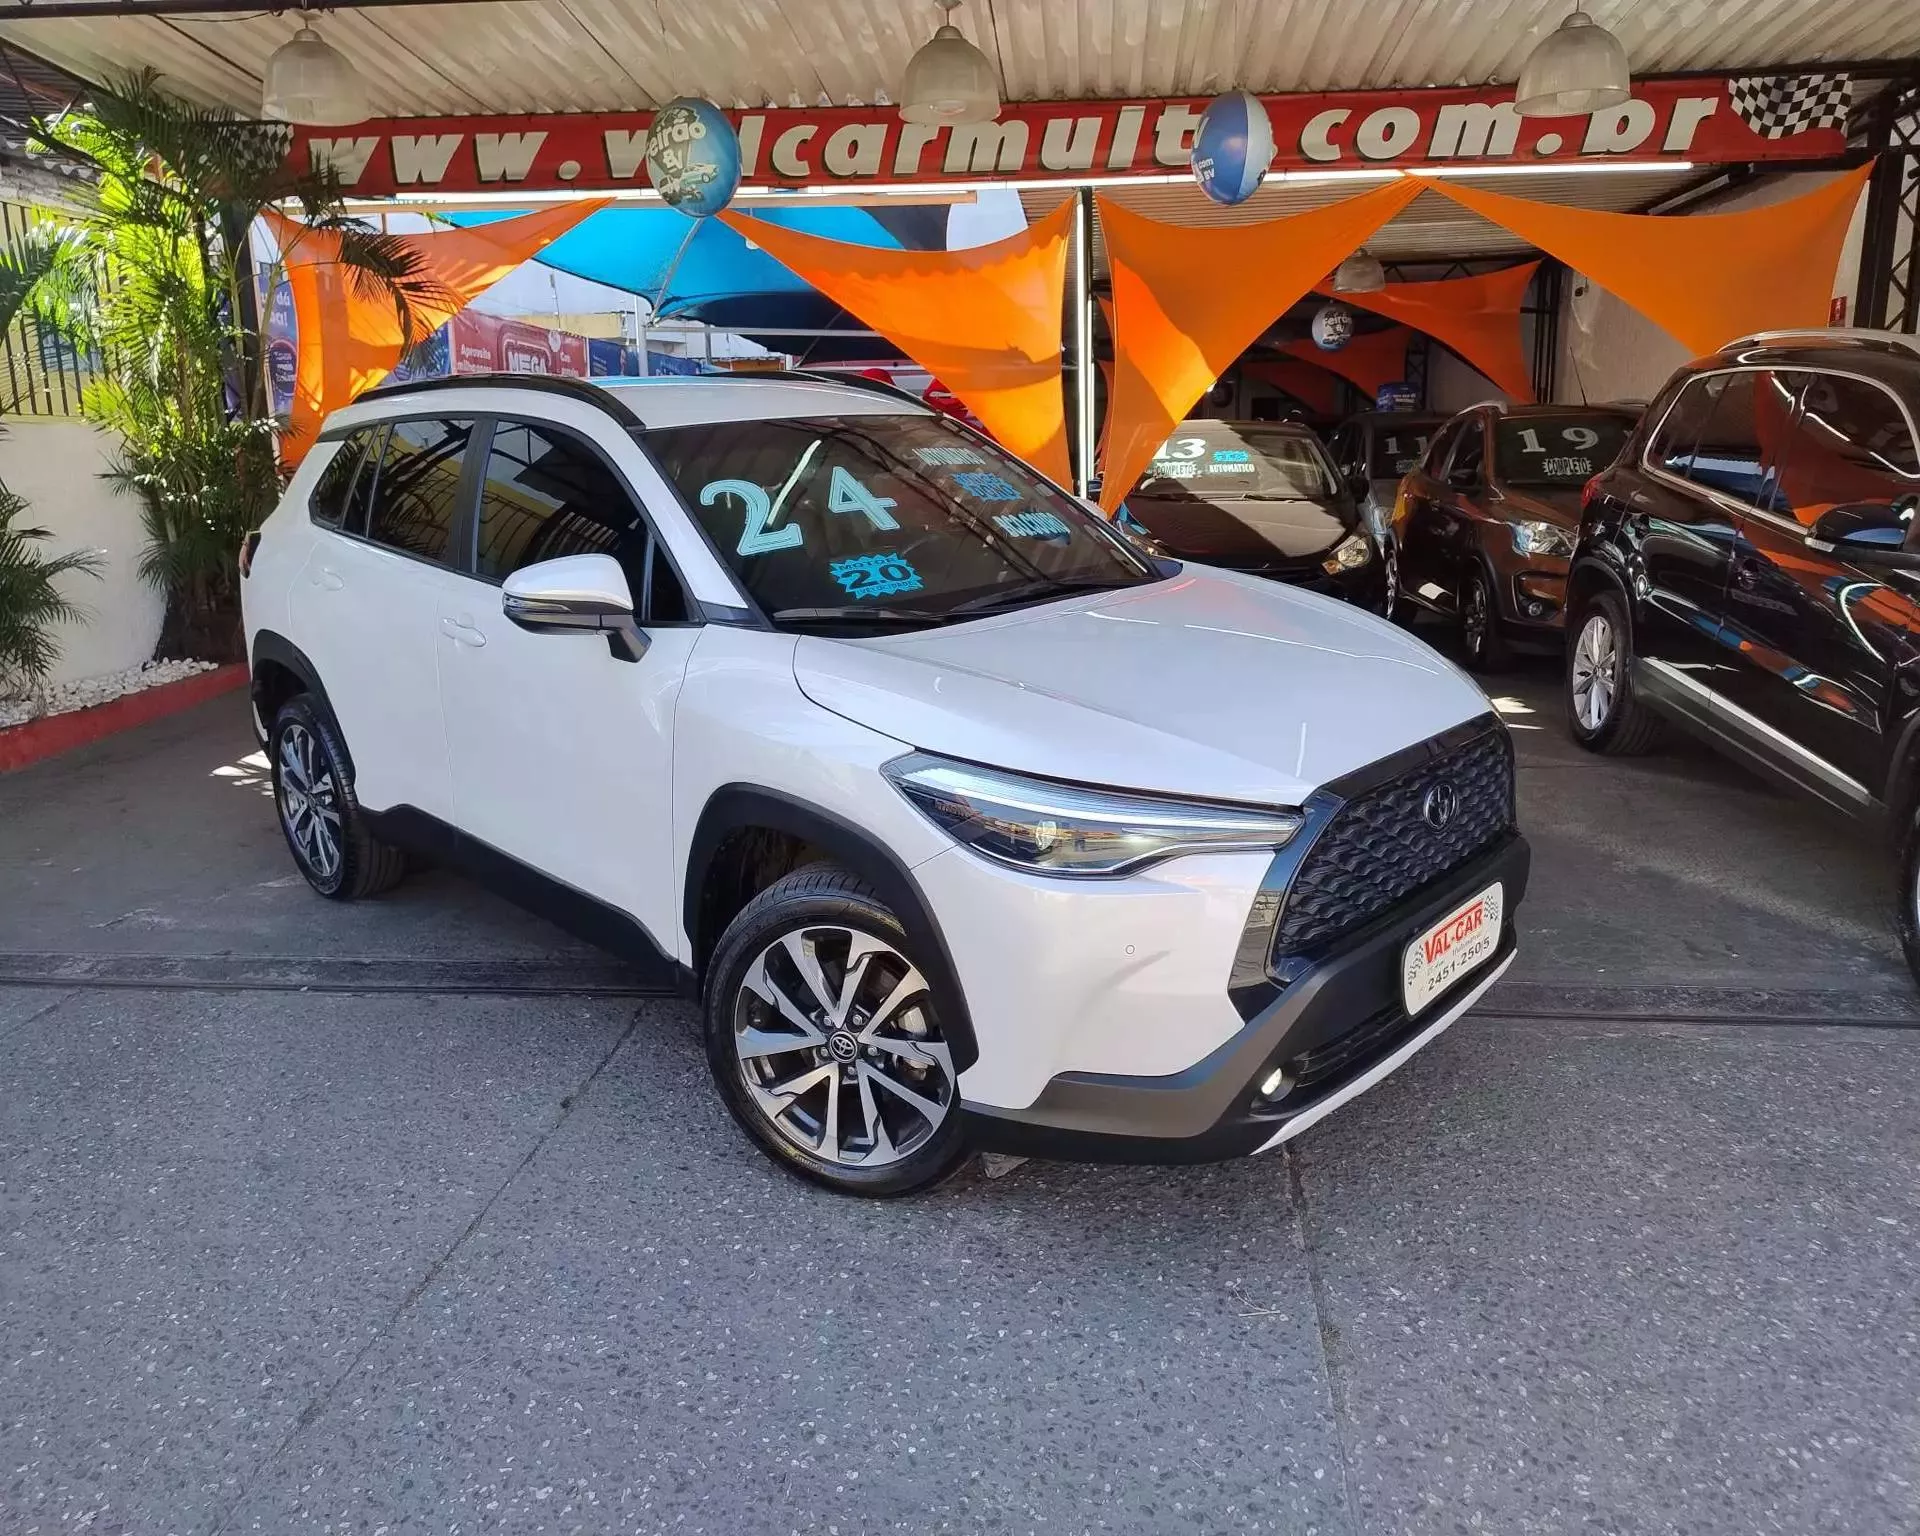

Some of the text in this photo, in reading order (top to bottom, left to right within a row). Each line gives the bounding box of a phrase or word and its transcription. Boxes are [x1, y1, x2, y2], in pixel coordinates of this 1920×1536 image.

[650, 117, 707, 157] eirão
[507, 350, 548, 374] MEGA
[1517, 427, 1599, 453] 19
[1156, 464, 1195, 476] COMPLETO
[1546, 459, 1589, 474] COMPLETO
[841, 563, 912, 590] 2.0
[1424, 901, 1484, 964] VAL-CAR
[1428, 936, 1490, 991] 2451-2505
